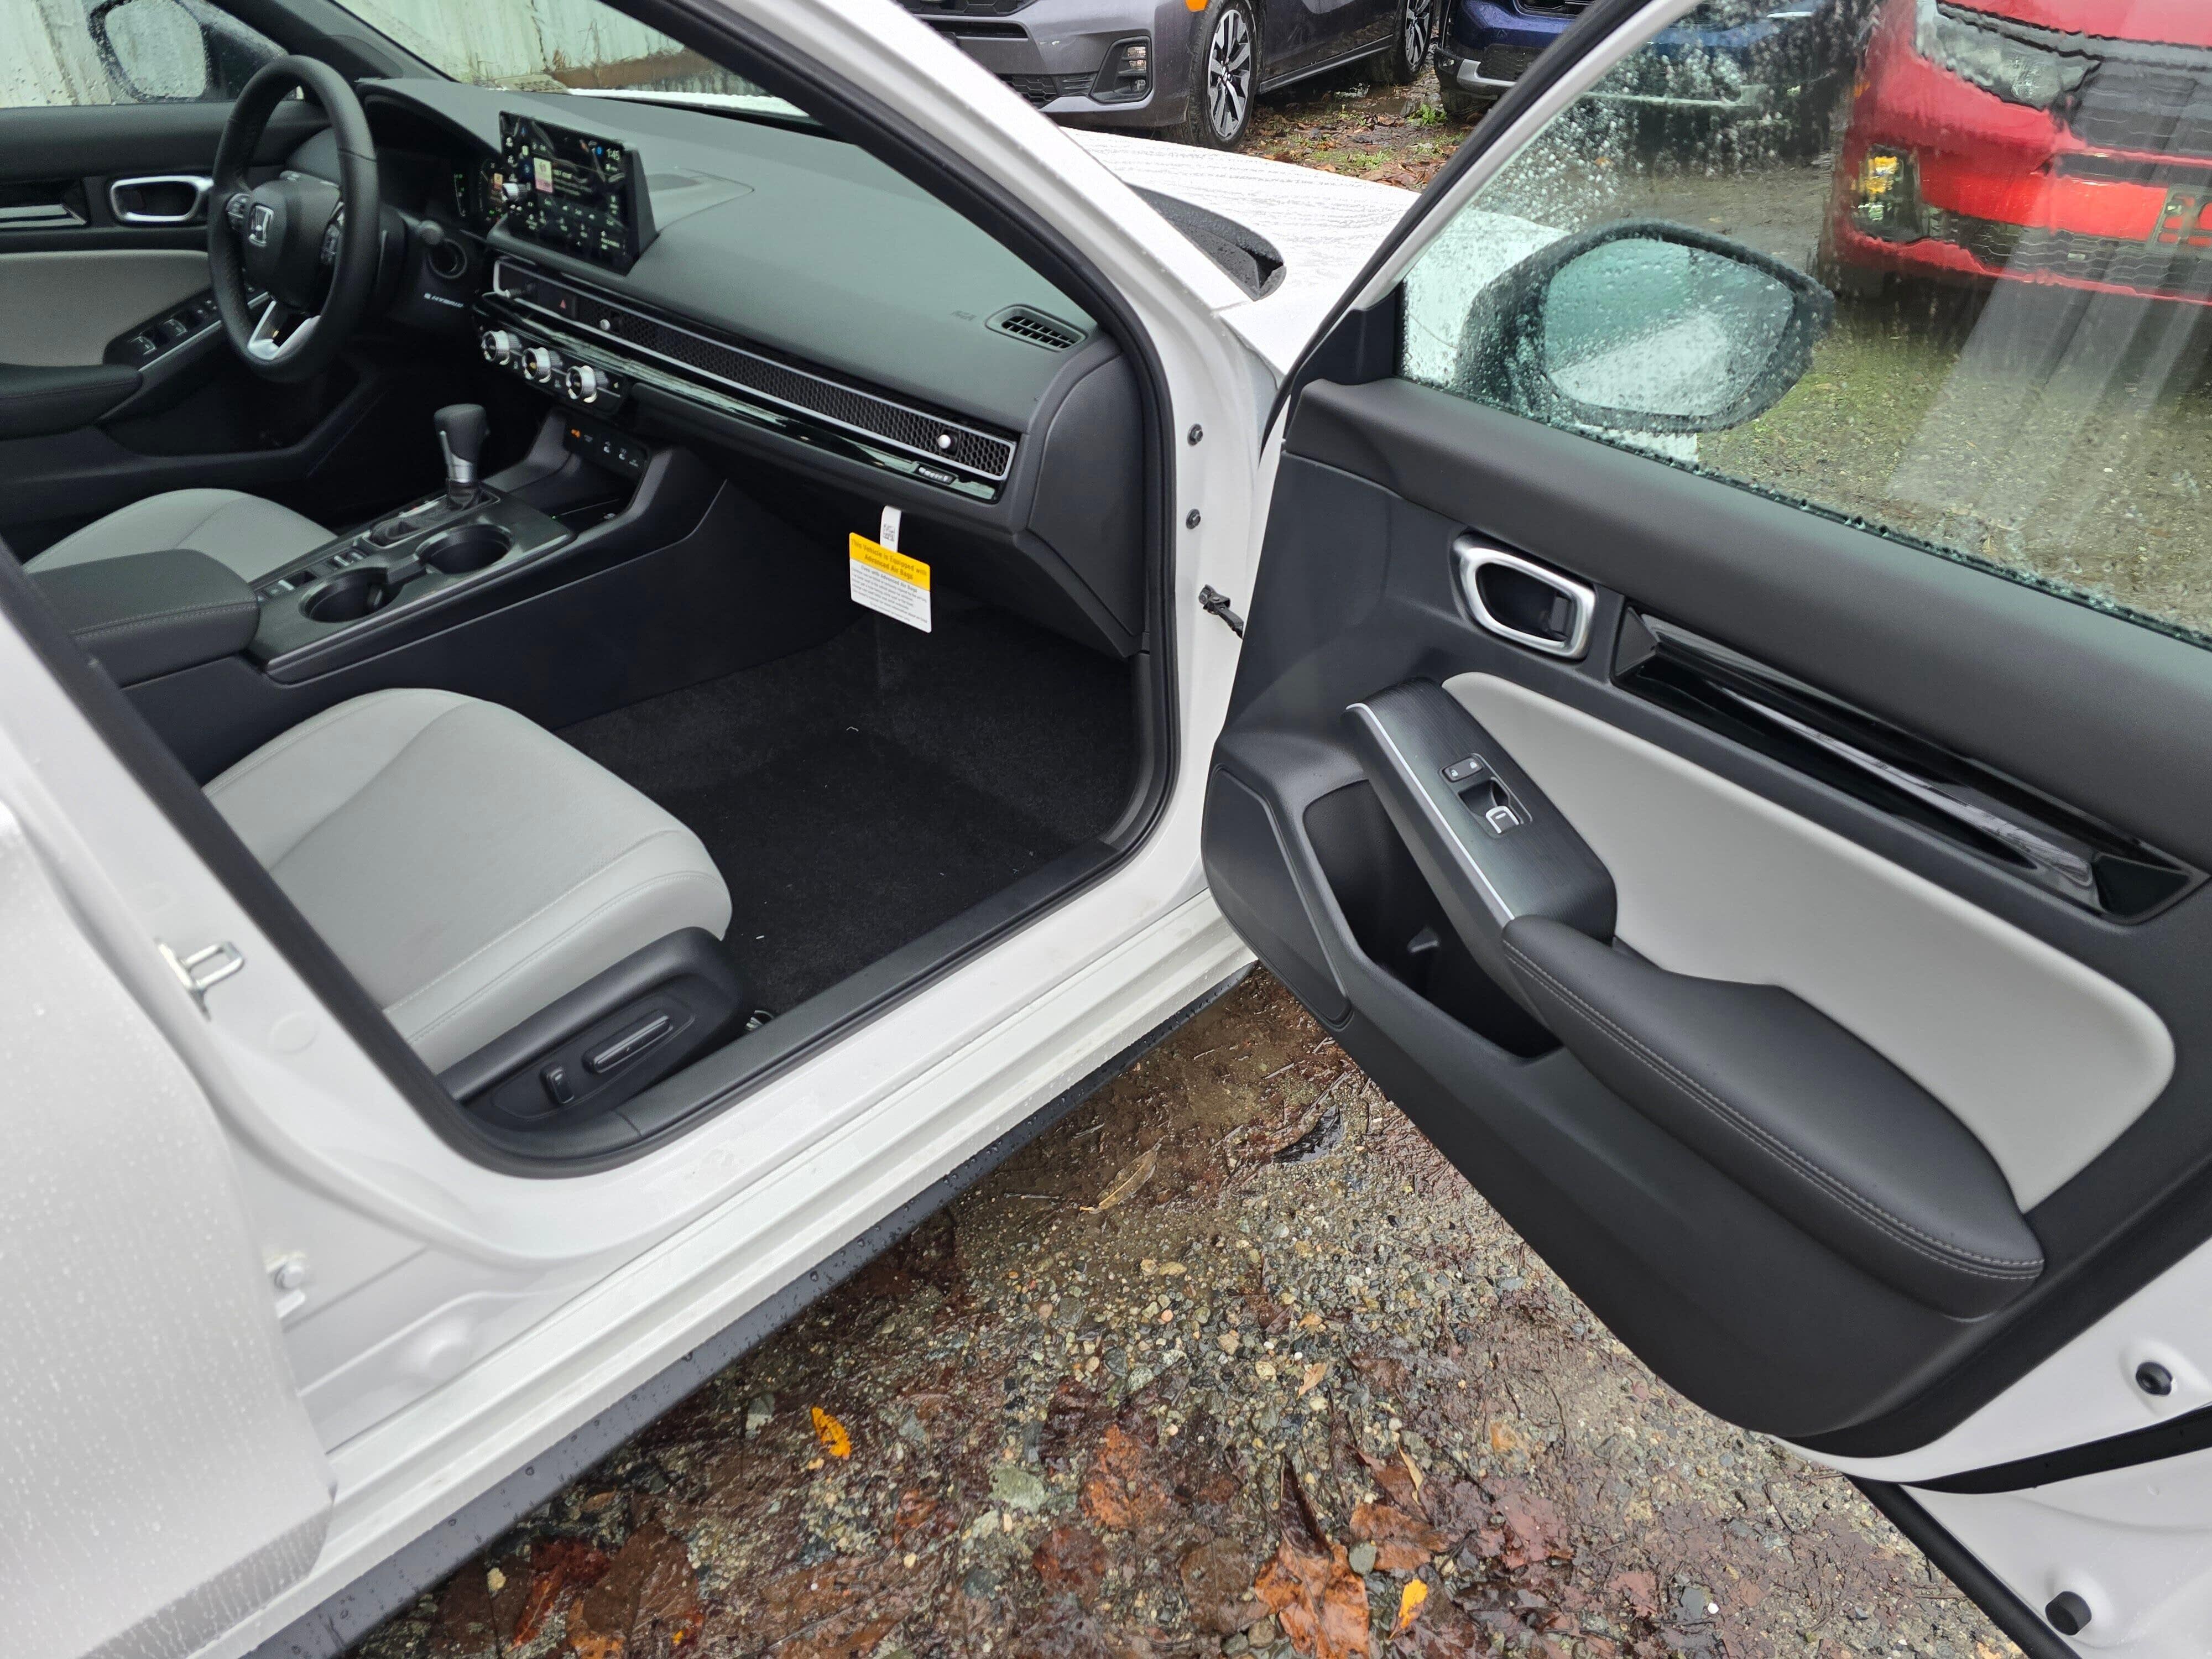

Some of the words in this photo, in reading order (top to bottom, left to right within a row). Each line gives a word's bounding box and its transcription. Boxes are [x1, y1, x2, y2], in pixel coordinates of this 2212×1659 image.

[852, 539, 862, 549] This
[863, 545, 881, 557] Vehicle
[889, 556, 914, 571] Equipped
[916, 567, 926, 576] with
[864, 555, 889, 568] Advanced
[900, 569, 913, 581] Bags
[880, 575, 899, 584] Advanced
